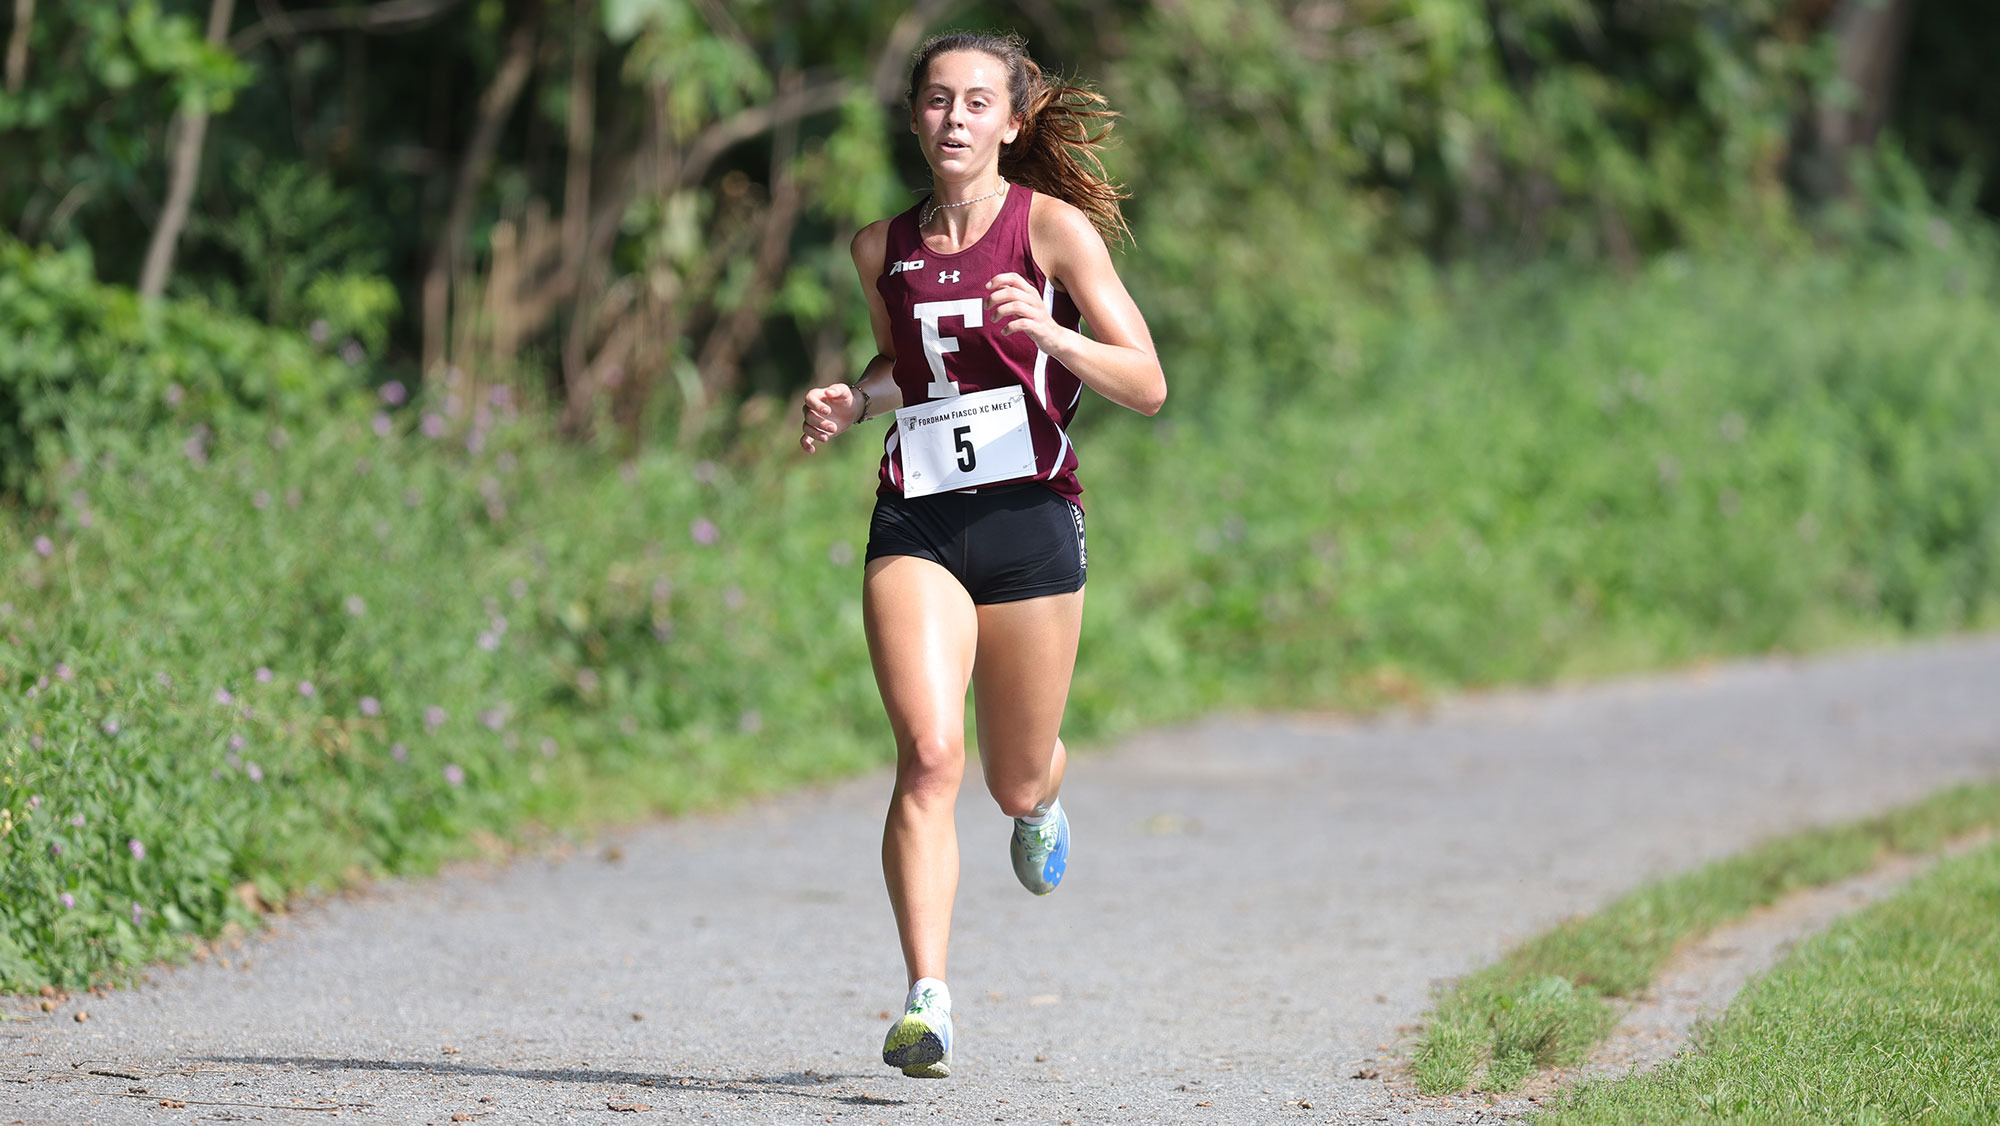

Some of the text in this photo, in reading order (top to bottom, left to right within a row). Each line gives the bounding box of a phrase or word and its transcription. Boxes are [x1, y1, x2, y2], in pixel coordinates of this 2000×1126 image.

[913, 297, 984, 399] F
[918, 402, 1012, 427] FORDHAM FIASCO XC MEET
[953, 425, 976, 473] 5
